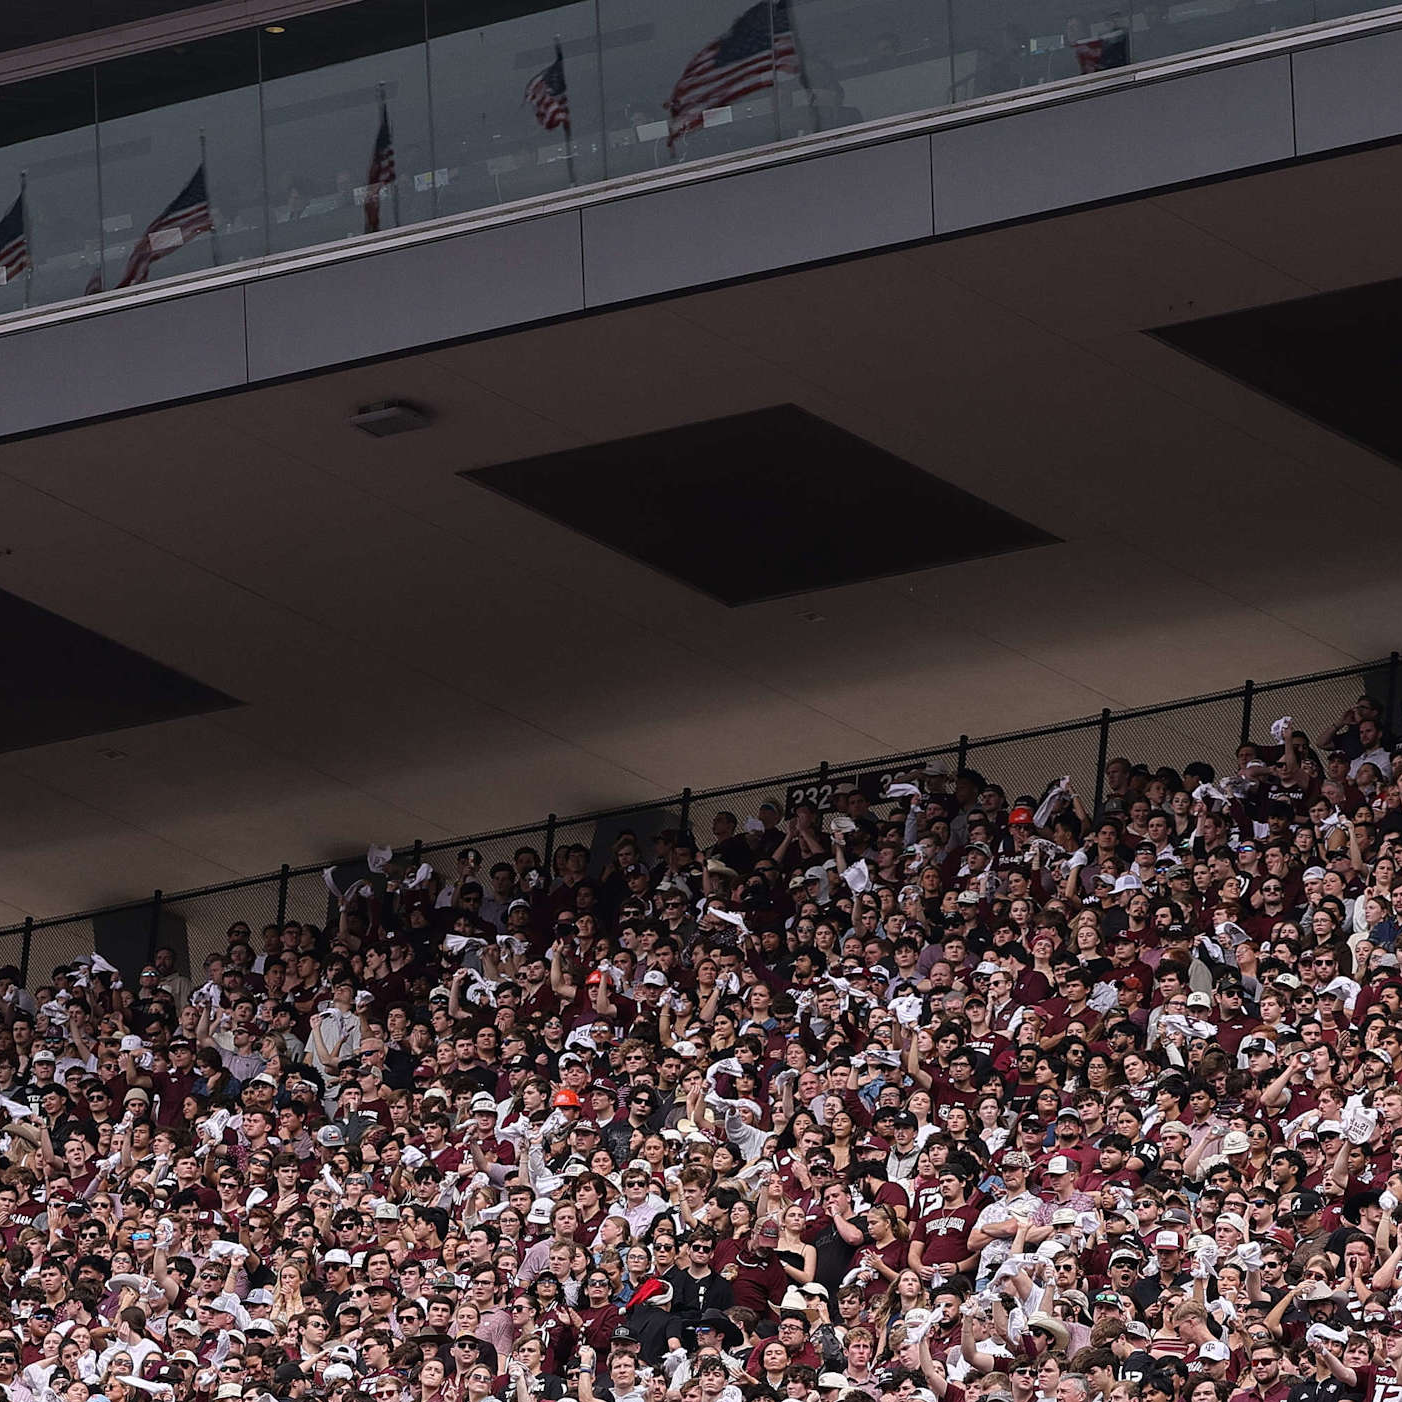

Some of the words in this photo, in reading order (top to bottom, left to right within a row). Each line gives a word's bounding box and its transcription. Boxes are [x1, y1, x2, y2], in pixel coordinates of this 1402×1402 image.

[1140, 1143, 1158, 1161] 12
[918, 1196, 942, 1217] 12
[1376, 1374, 1398, 1384] TEXAS
